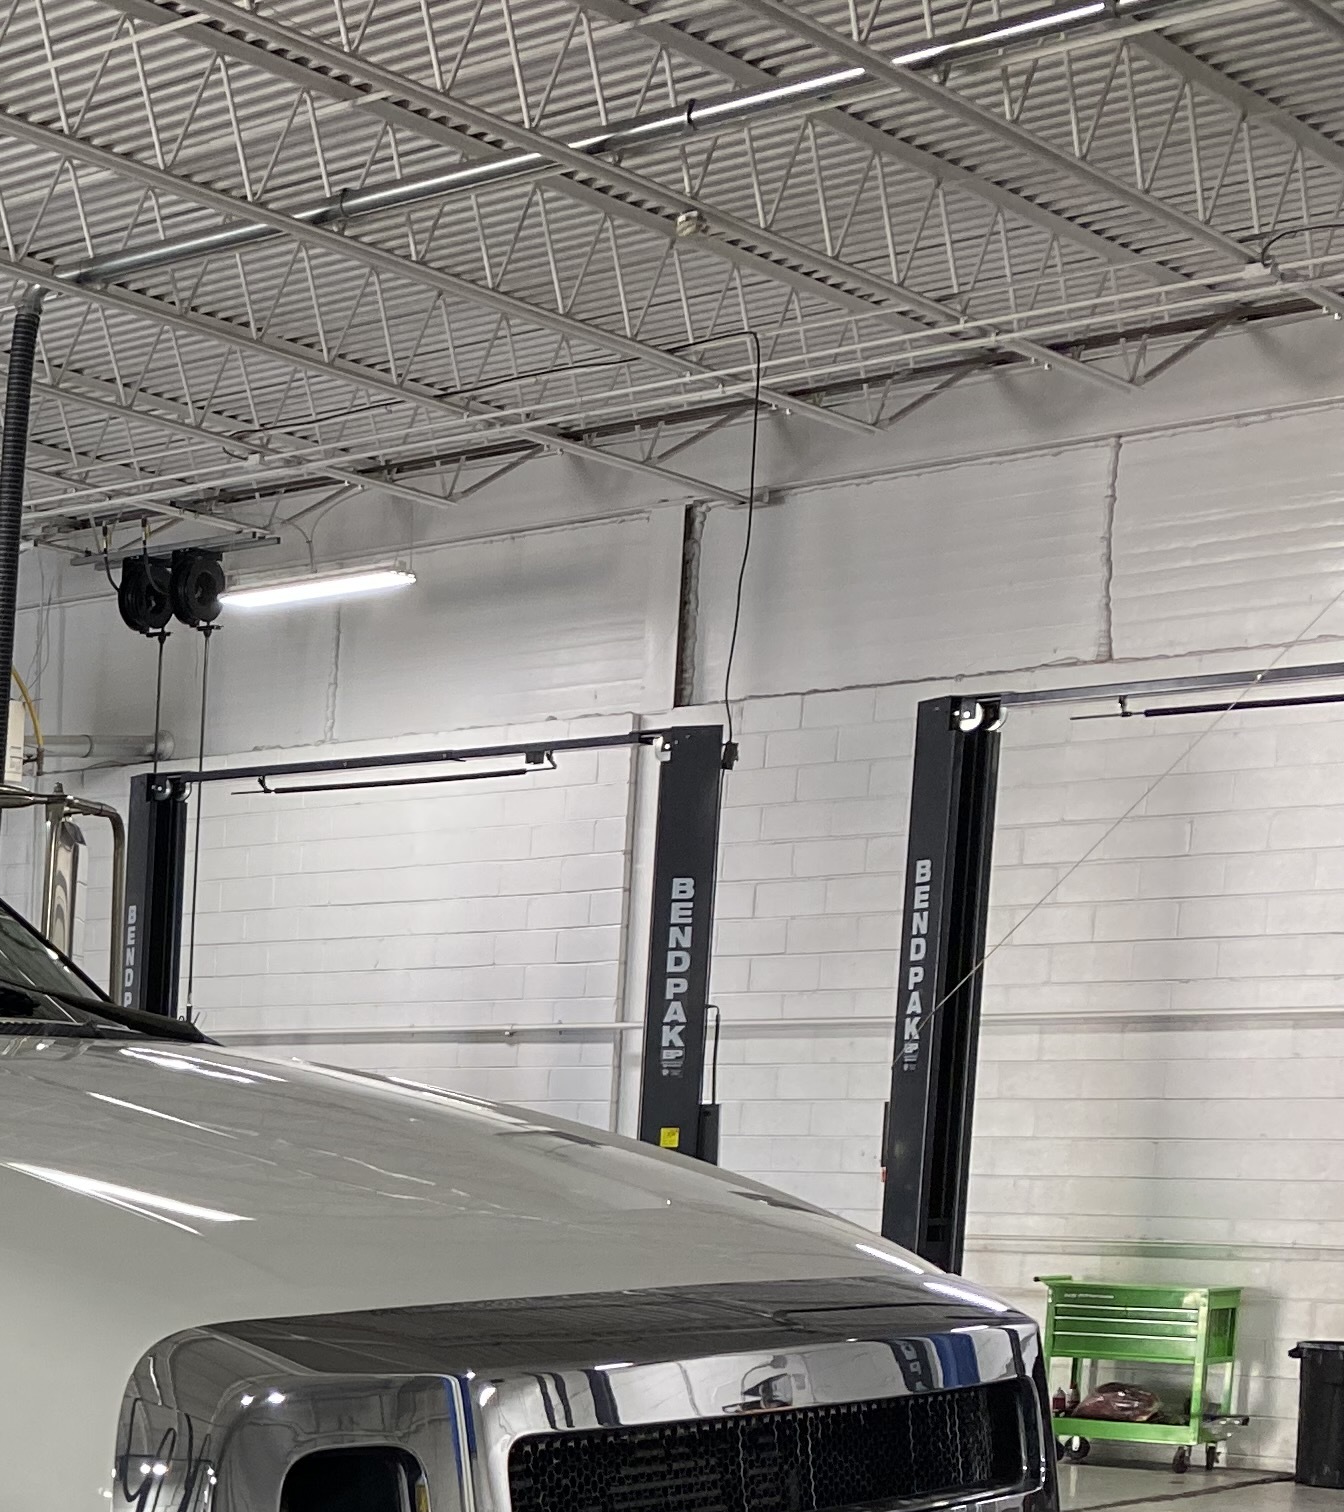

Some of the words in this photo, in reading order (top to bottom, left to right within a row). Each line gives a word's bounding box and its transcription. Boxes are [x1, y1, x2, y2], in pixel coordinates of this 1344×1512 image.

[123, 904, 137, 1008] BENDP
[660, 877, 695, 1047] BENDPAK
[903, 859, 933, 1040] BENDPAK
